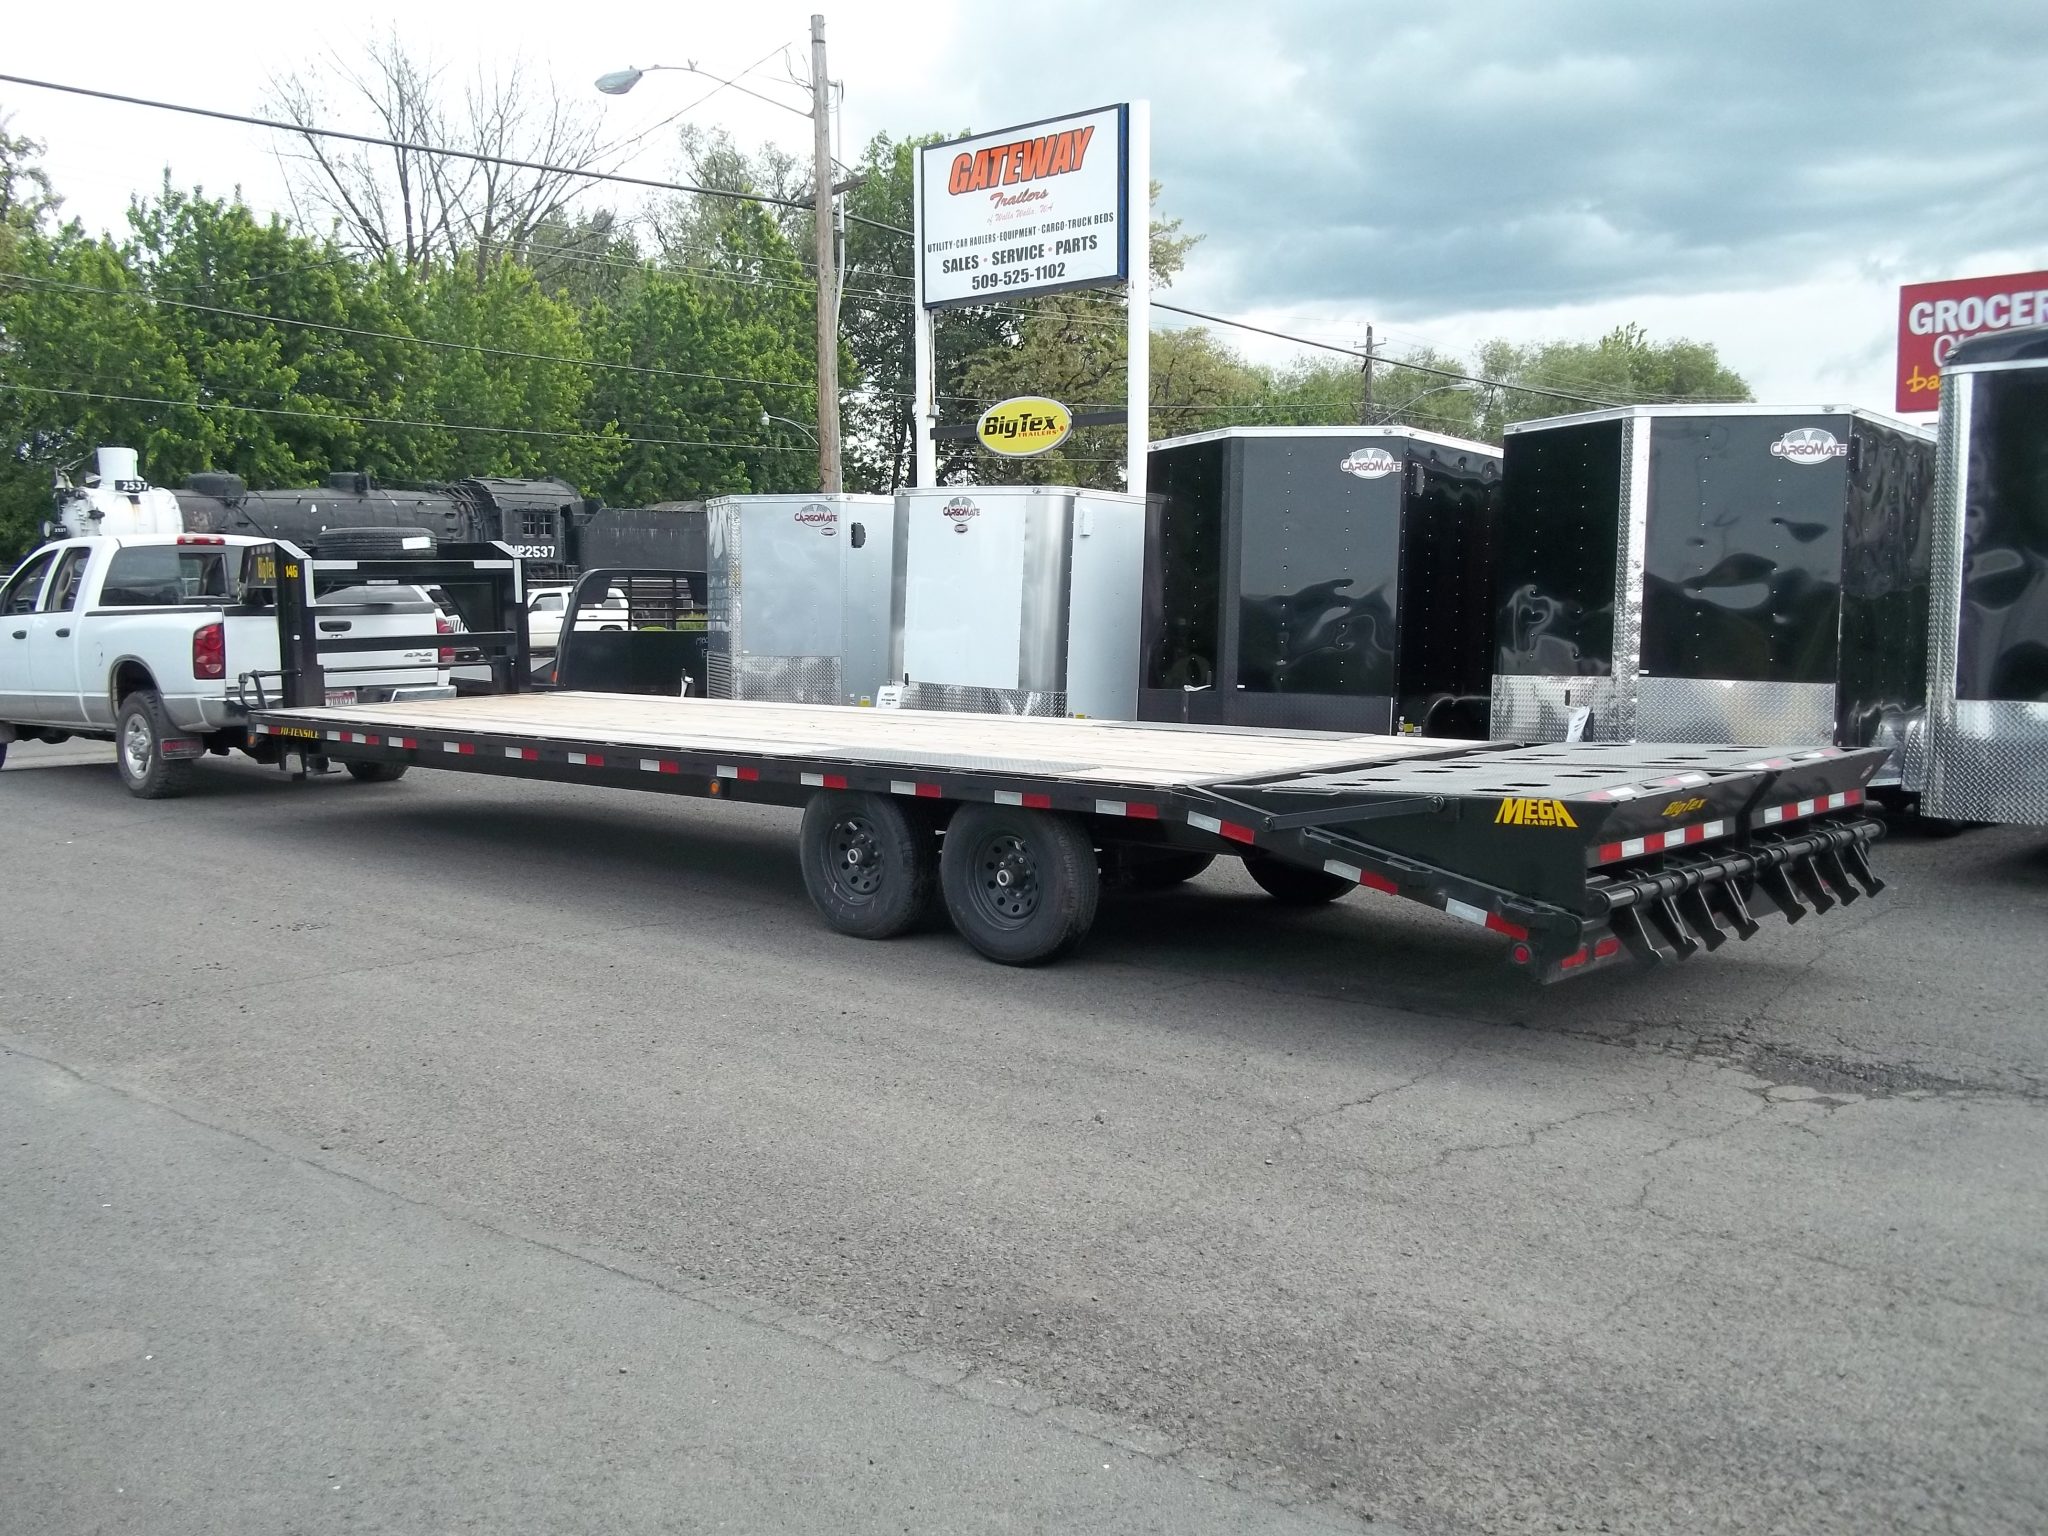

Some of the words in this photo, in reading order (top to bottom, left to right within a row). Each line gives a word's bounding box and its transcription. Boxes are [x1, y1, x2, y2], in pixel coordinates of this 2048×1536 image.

[948, 125, 1095, 195] GATEWAY
[990, 188, 1049, 209] Trailers
[927, 240, 953, 253] UTILITY
[955, 238, 968, 249] CAR
[969, 233, 996, 246] HAULERS
[999, 226, 1037, 242] EQUIPMENT
[1041, 220, 1065, 234] CARGO
[1067, 215, 1092, 230] TRUCK
[1093, 212, 1114, 225] BEDS
[942, 254, 980, 274] SALES
[991, 243, 1045, 266] SERVICE
[1055, 234, 1098, 256] PARTS
[971, 261, 1066, 291] 509-525-1102
[1018, 429, 1057, 438] TRAILERS
[122, 481, 148, 491] 2537
[1494, 797, 1579, 828] MEGA
[1523, 818, 1556, 826] RAMP
